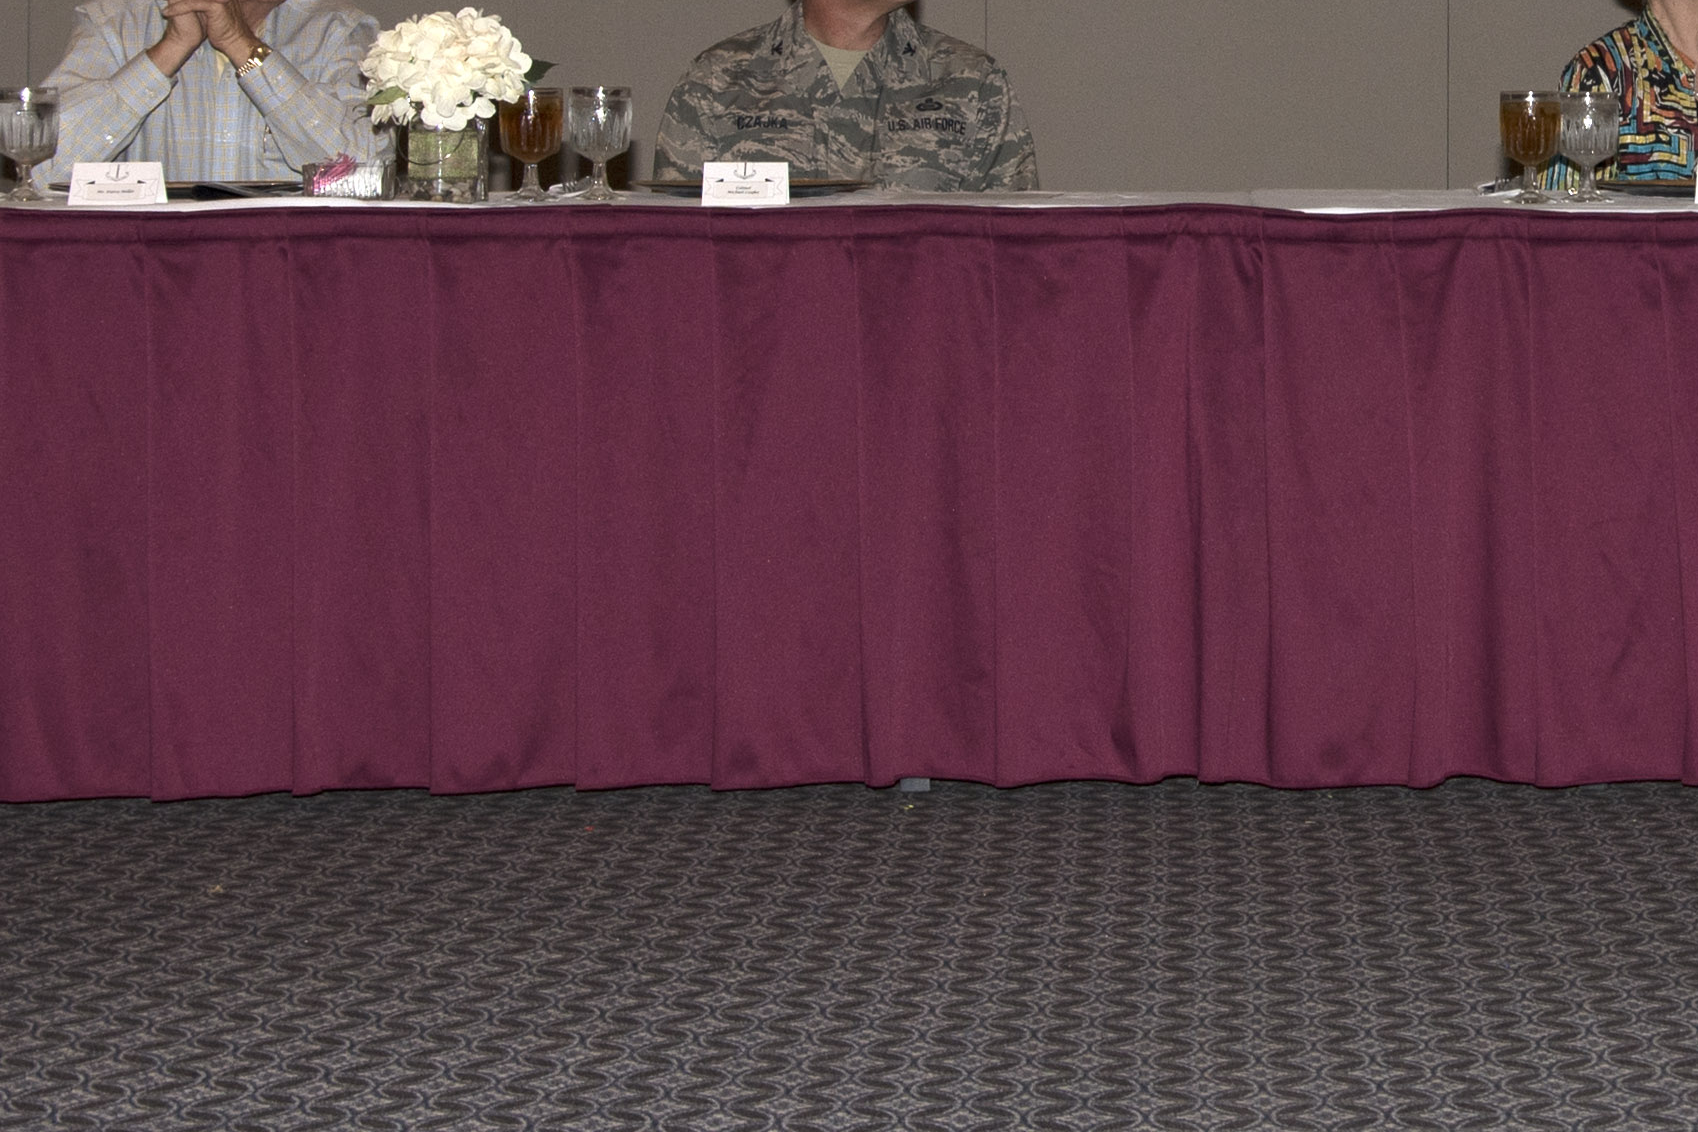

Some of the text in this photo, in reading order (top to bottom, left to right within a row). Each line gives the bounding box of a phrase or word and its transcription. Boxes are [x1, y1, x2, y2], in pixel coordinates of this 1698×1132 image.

[737, 115, 789, 130] CZAJKA
[912, 117, 933, 131] AIR
[934, 116, 968, 136] FORCE
